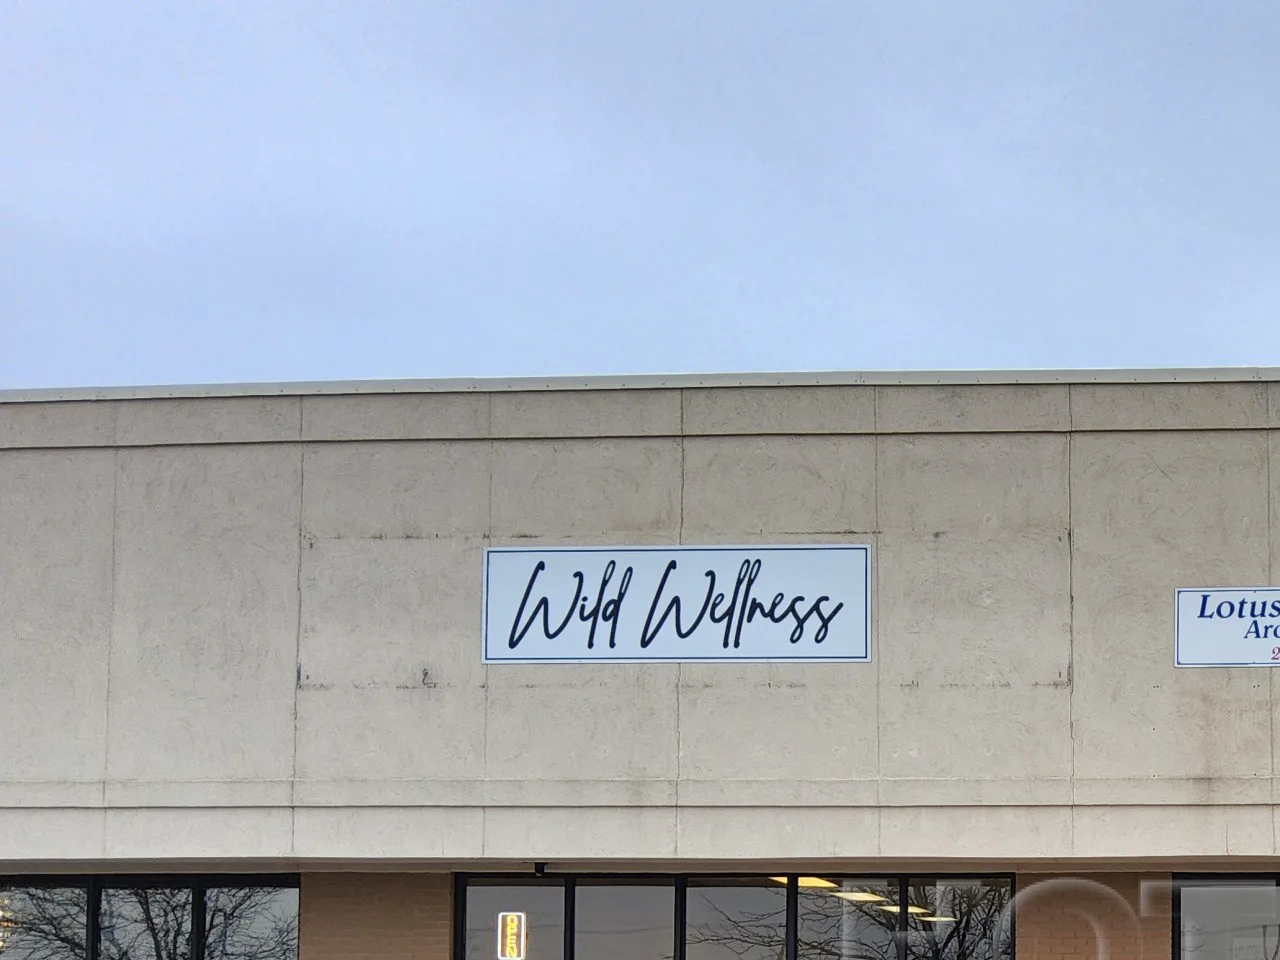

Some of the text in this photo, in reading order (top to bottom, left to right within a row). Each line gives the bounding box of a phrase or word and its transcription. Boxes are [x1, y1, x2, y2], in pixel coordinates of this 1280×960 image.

[509, 559, 844, 649] Wild Wellness
[506, 914, 518, 958] OPEN
